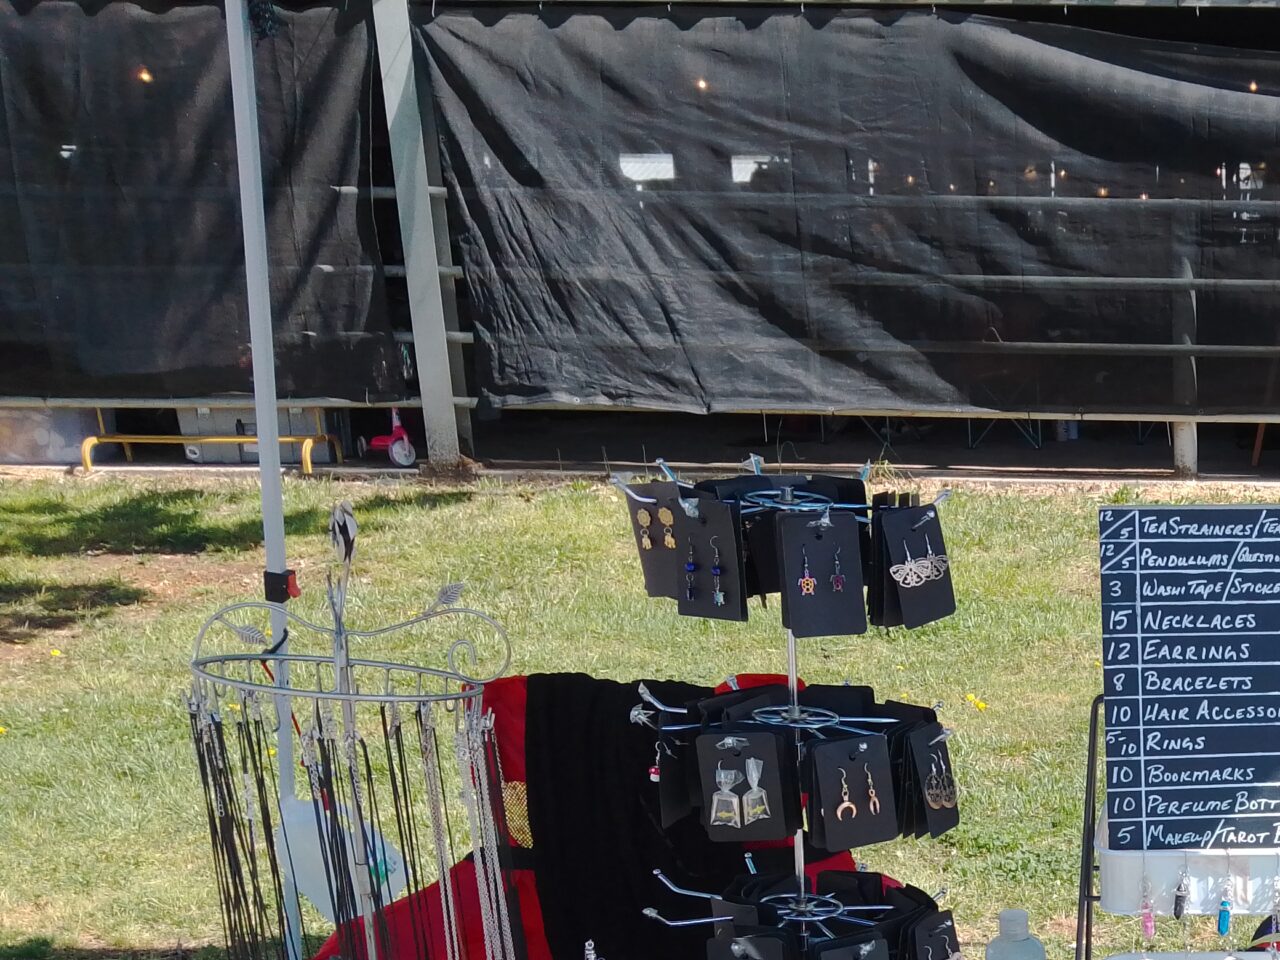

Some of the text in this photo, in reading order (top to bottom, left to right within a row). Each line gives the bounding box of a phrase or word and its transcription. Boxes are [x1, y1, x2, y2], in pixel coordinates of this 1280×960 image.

[1141, 516, 1166, 535] TEA
[1110, 581, 1122, 597] 3
[1109, 610, 1257, 630] 15 NECKLACES
[1107, 639, 1250, 661] 12 EARRINGS
[1113, 671, 1253, 692] 8 BRACELETS
[1111, 705, 1131, 724] 10
[1144, 703, 1190, 721] HAIR
[1145, 732, 1206, 751] RINGS
[1112, 764, 1255, 784] 10 BOOKMARKS
[1113, 796, 1136, 814] 10
[1146, 795, 1232, 814] PERFUME
[1117, 826, 1136, 845] 5
